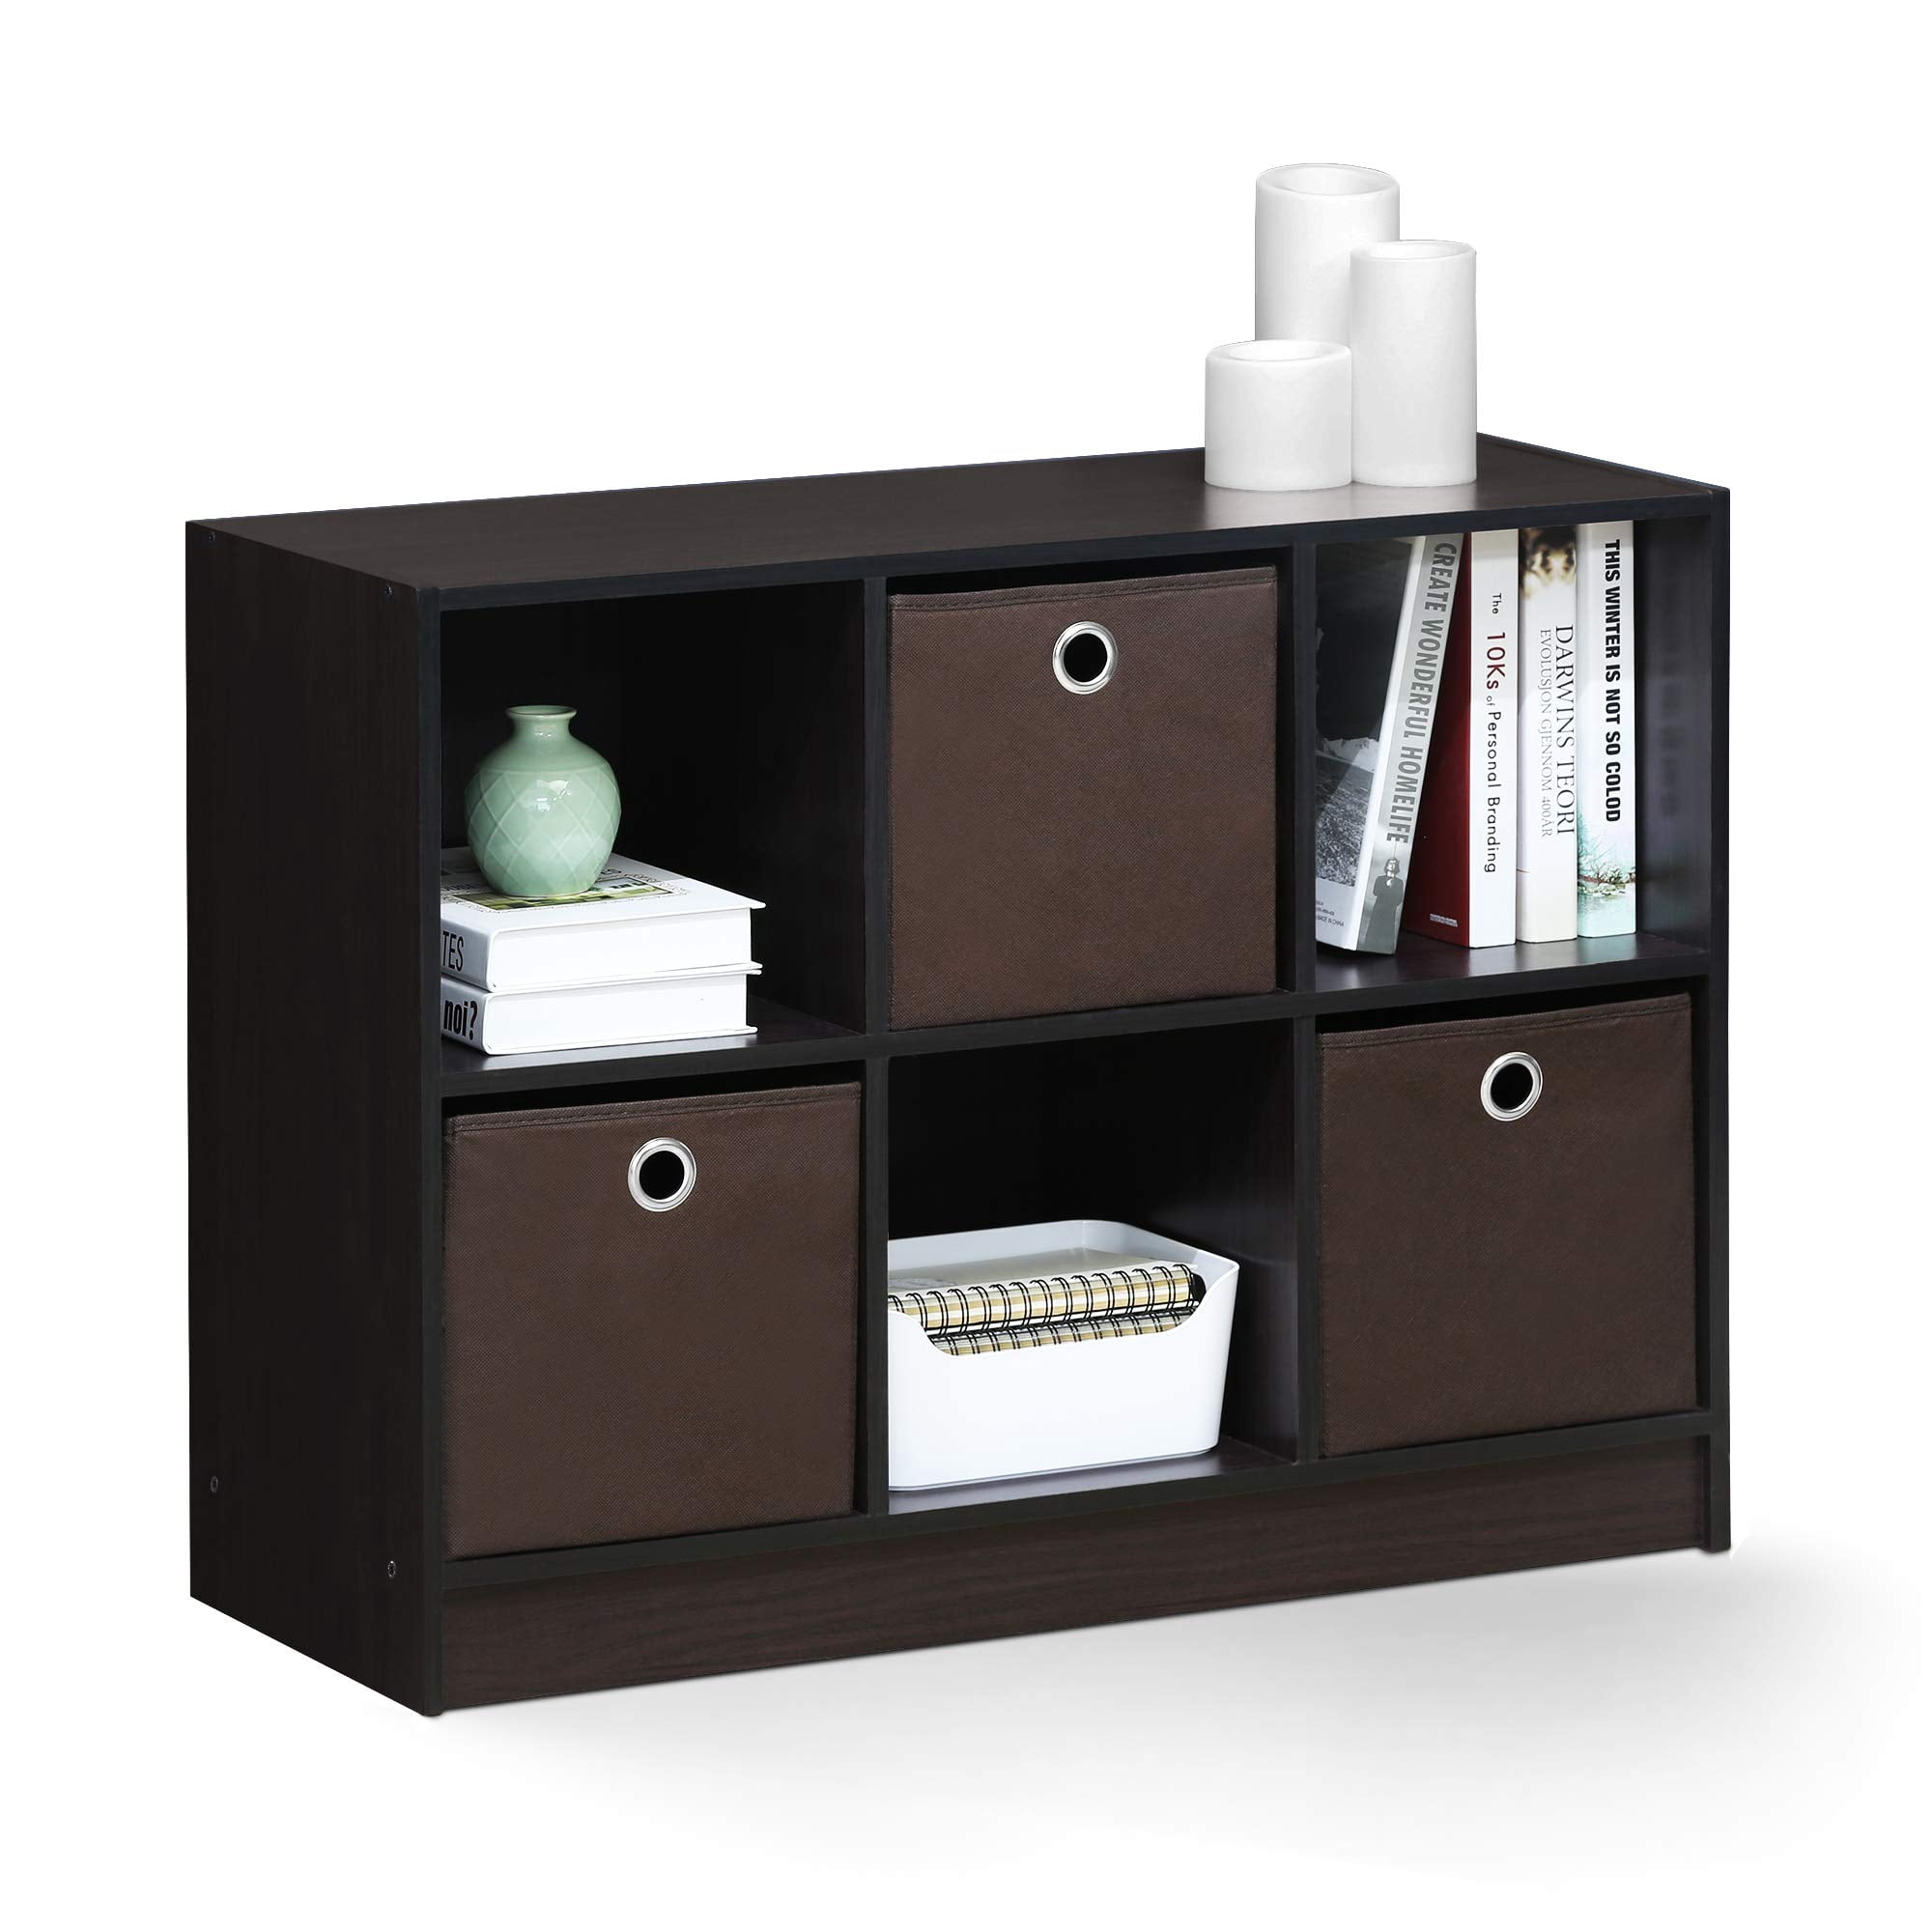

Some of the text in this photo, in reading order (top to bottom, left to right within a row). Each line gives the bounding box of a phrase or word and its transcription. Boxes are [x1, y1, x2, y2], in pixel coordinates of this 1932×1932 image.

[1386, 542, 1457, 844] CREATE WONDERFUL HOMELIFE
[1483, 592, 1506, 873] The 10Ks of Personal Branding
[1538, 629, 1552, 714] EVOLUSJON
[1538, 719, 1552, 791] GJENNOM
[1555, 624, 1576, 835] DARWINS TEORI
[1605, 538, 1621, 822] THIS WINTER IS NOT SO COLOD
[443, 1000, 478, 1040] noi?
